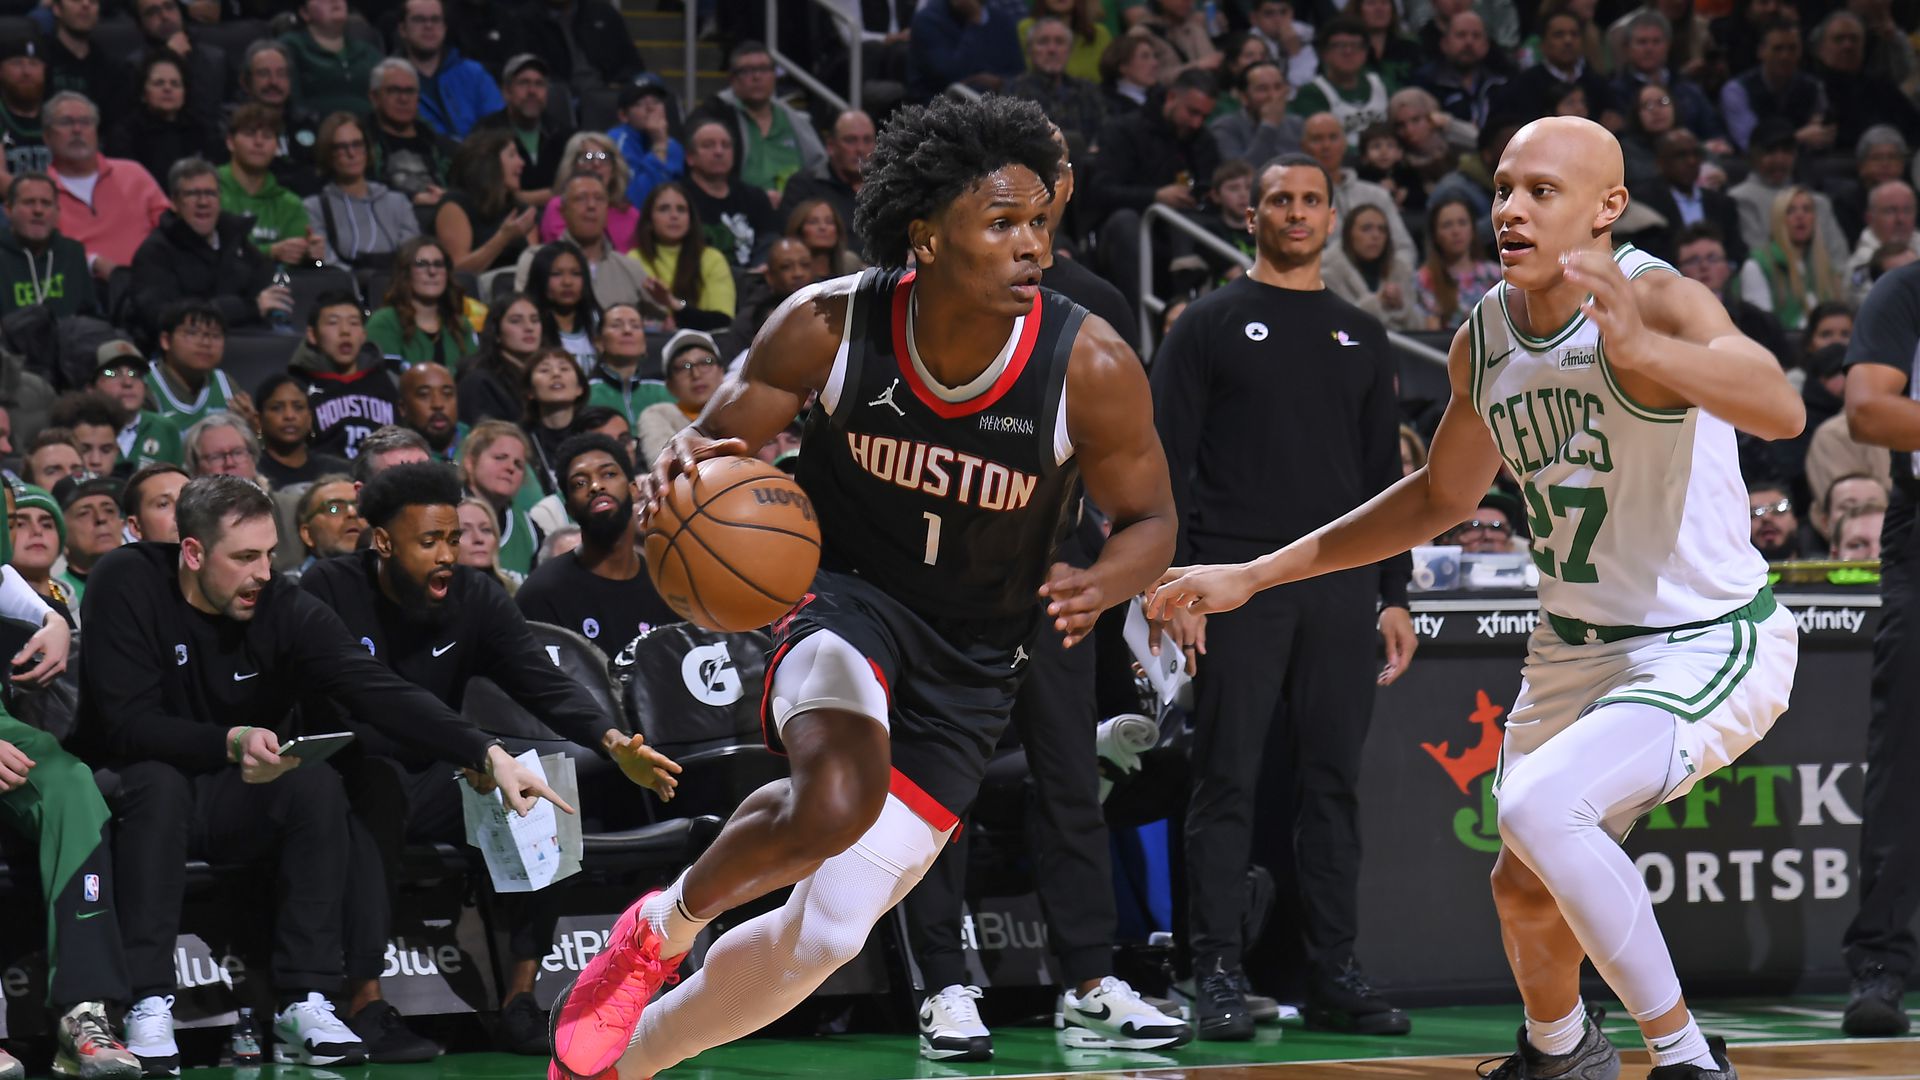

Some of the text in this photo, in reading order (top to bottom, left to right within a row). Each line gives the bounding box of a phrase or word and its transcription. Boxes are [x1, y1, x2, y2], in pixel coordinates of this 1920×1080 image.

[1561, 350, 1596, 367] Amica
[315, 393, 394, 432] HOUSTON
[979, 421, 1034, 435] HERMANN
[980, 415, 1033, 428] MEMORIAL
[1489, 388, 1614, 476] CELTICS
[847, 431, 1039, 512] HOUSTON
[923, 511, 942, 566] 1
[1524, 481, 1608, 583] 27
[1476, 610, 1540, 638] xfinit
[1793, 606, 1866, 634] xfinity
[1635, 848, 1849, 904] ORTSB
